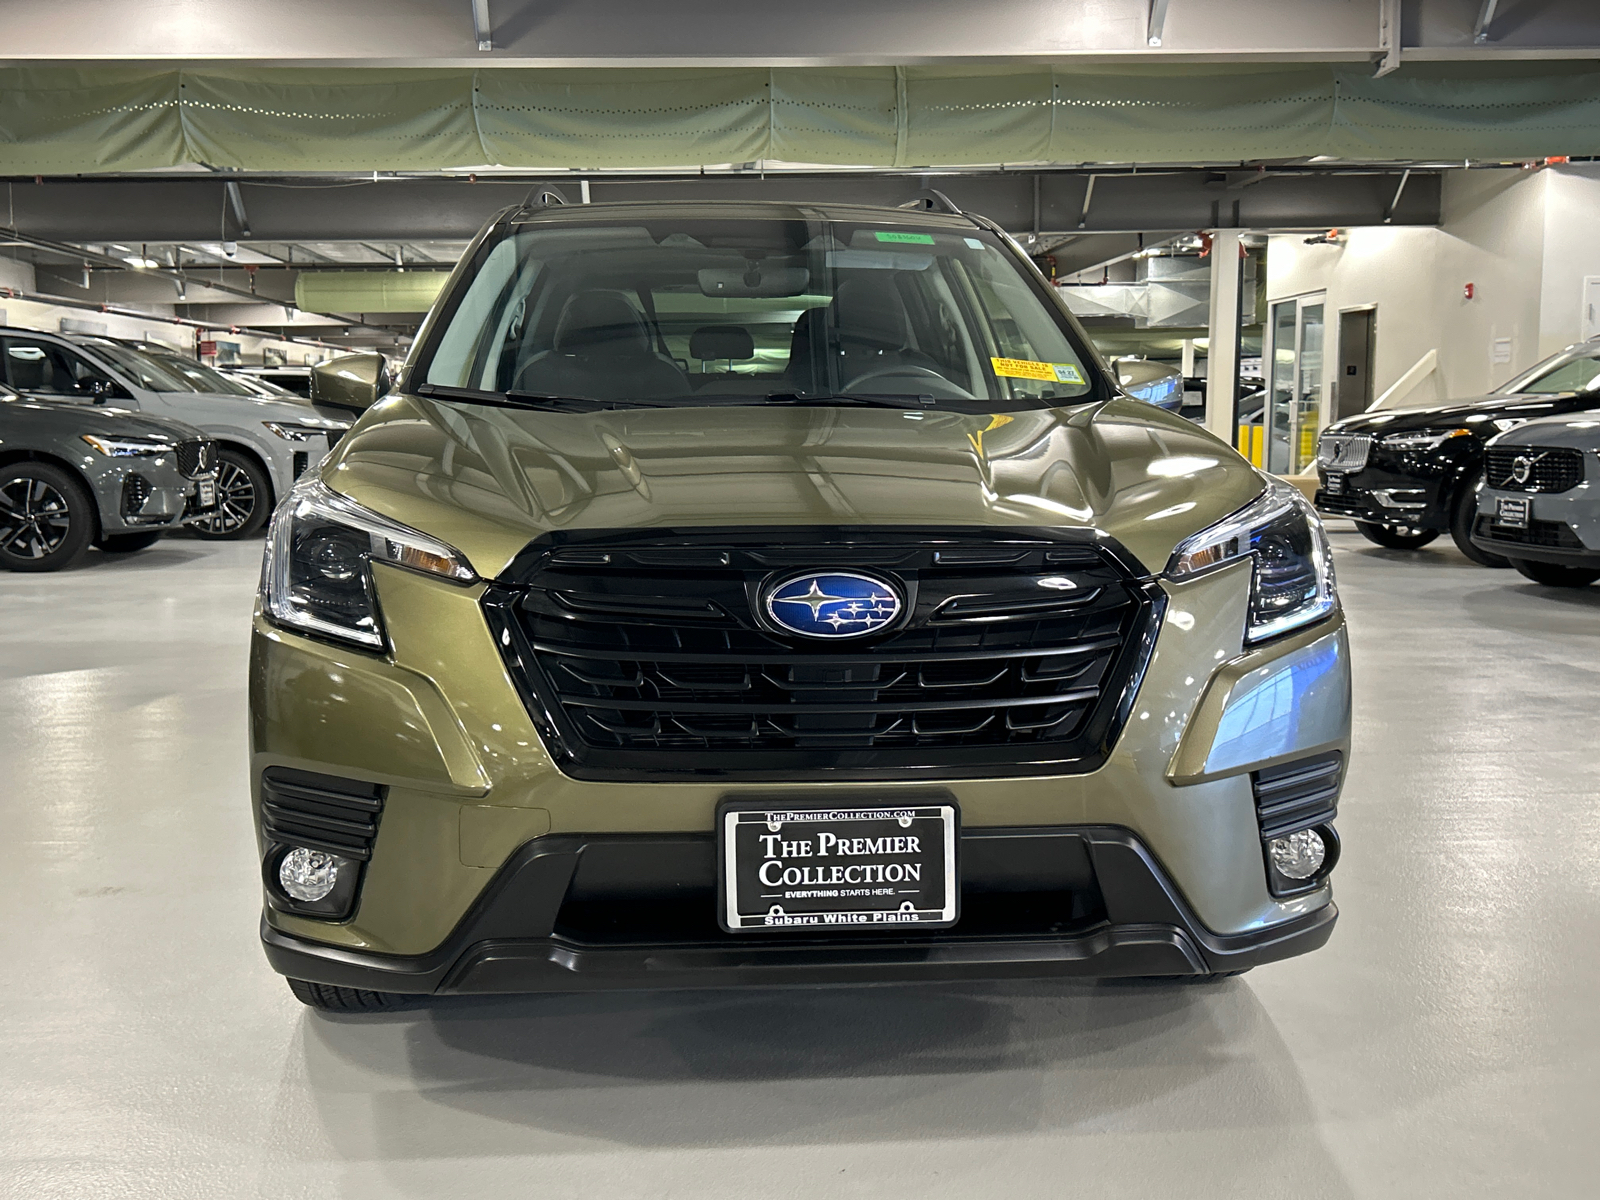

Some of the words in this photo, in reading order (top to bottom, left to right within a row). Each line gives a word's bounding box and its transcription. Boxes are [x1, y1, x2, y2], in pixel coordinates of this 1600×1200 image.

[759, 834, 812, 858] THE
[817, 832, 921, 856] PREMIER
[759, 861, 921, 887] COLLECTION
[785, 890, 839, 899] EVERYTHING
[840, 889, 870, 897] STARTS
[871, 888, 895, 896] HERE.
[765, 915, 818, 926] Subaru
[824, 913, 867, 923] White
[873, 911, 919, 922] Plains
